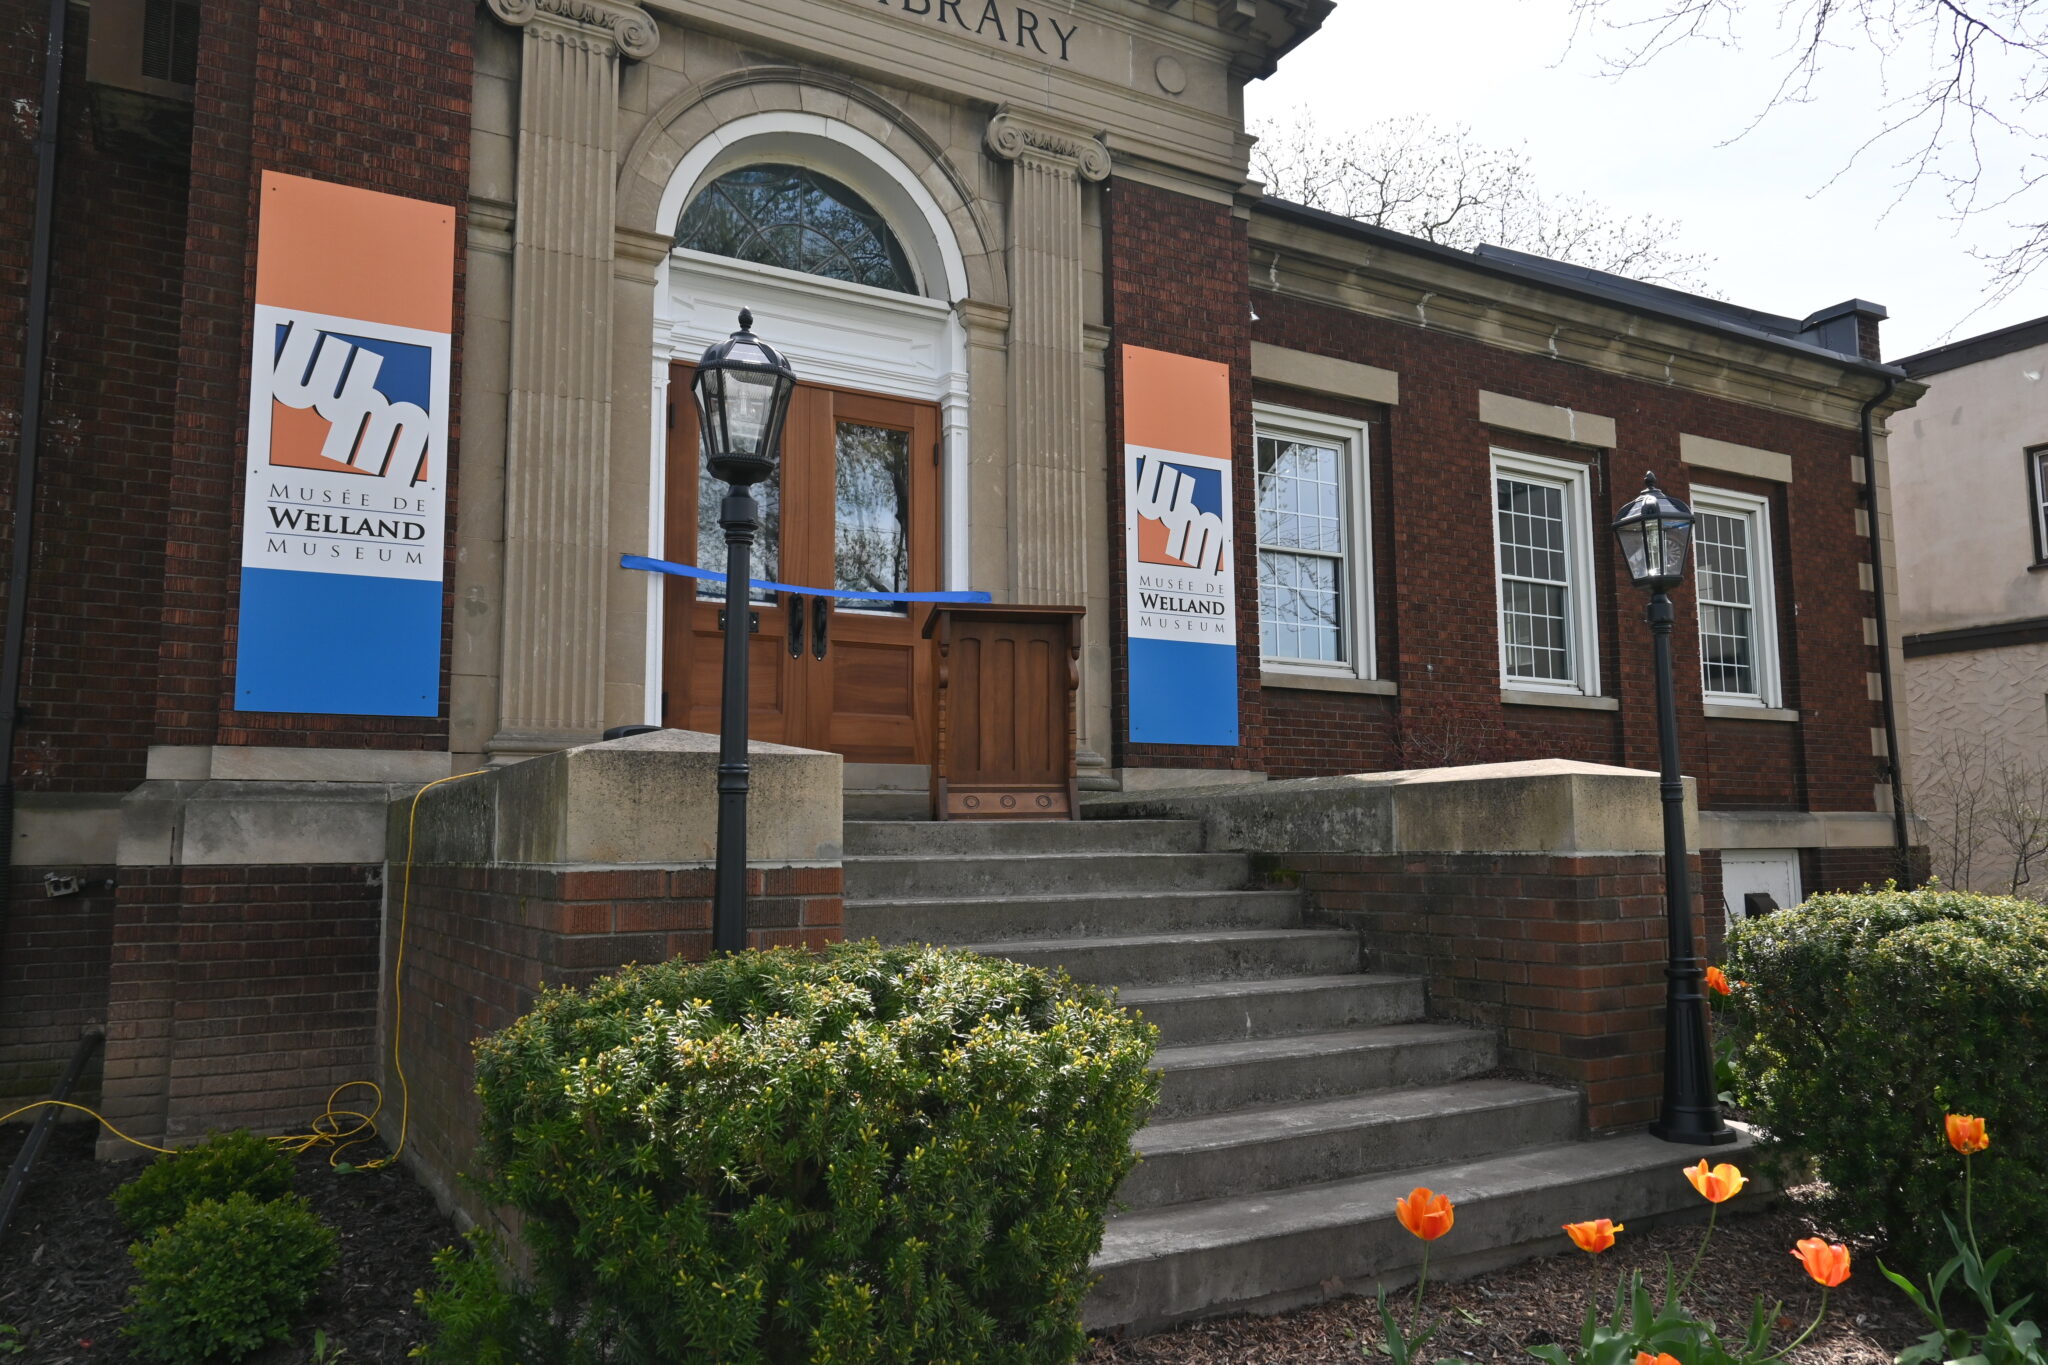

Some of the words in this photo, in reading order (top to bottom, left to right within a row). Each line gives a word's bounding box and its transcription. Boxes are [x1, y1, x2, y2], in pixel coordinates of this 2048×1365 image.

[878, 0, 1078, 61] RARY
[270, 483, 370, 507] MUSÉE
[394, 496, 425, 512] DE
[267, 506, 426, 541] WELLAND
[266, 538, 423, 565] MUSEUM
[1139, 575, 1194, 591] MUSÉE
[1206, 583, 1224, 594] DE
[1139, 592, 1225, 616] WELLAND
[1140, 616, 1225, 633] MUSEUM
